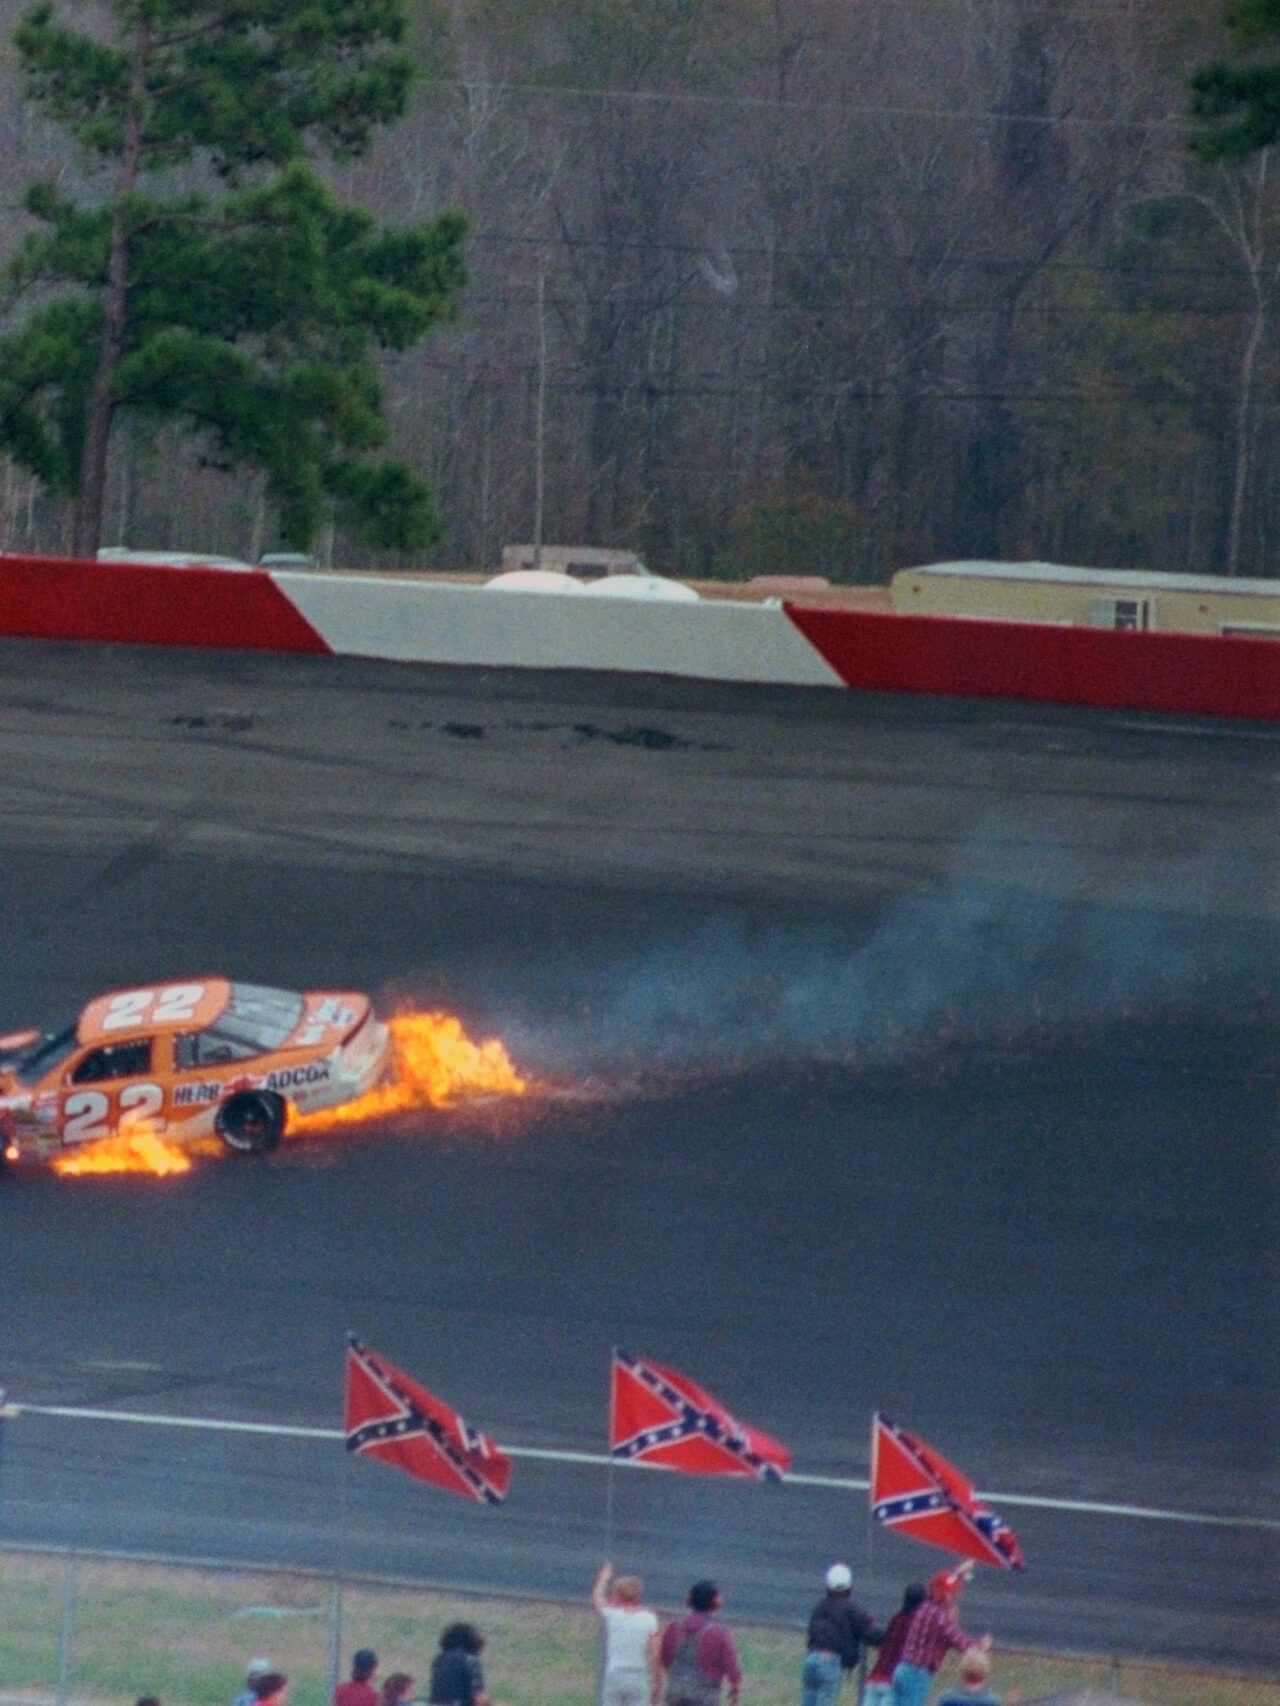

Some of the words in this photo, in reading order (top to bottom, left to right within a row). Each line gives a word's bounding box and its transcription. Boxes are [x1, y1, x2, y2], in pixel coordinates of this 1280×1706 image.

[102, 985, 205, 1031] 22
[266, 1059, 331, 1090] ADCOX
[63, 1083, 168, 1147] 22
